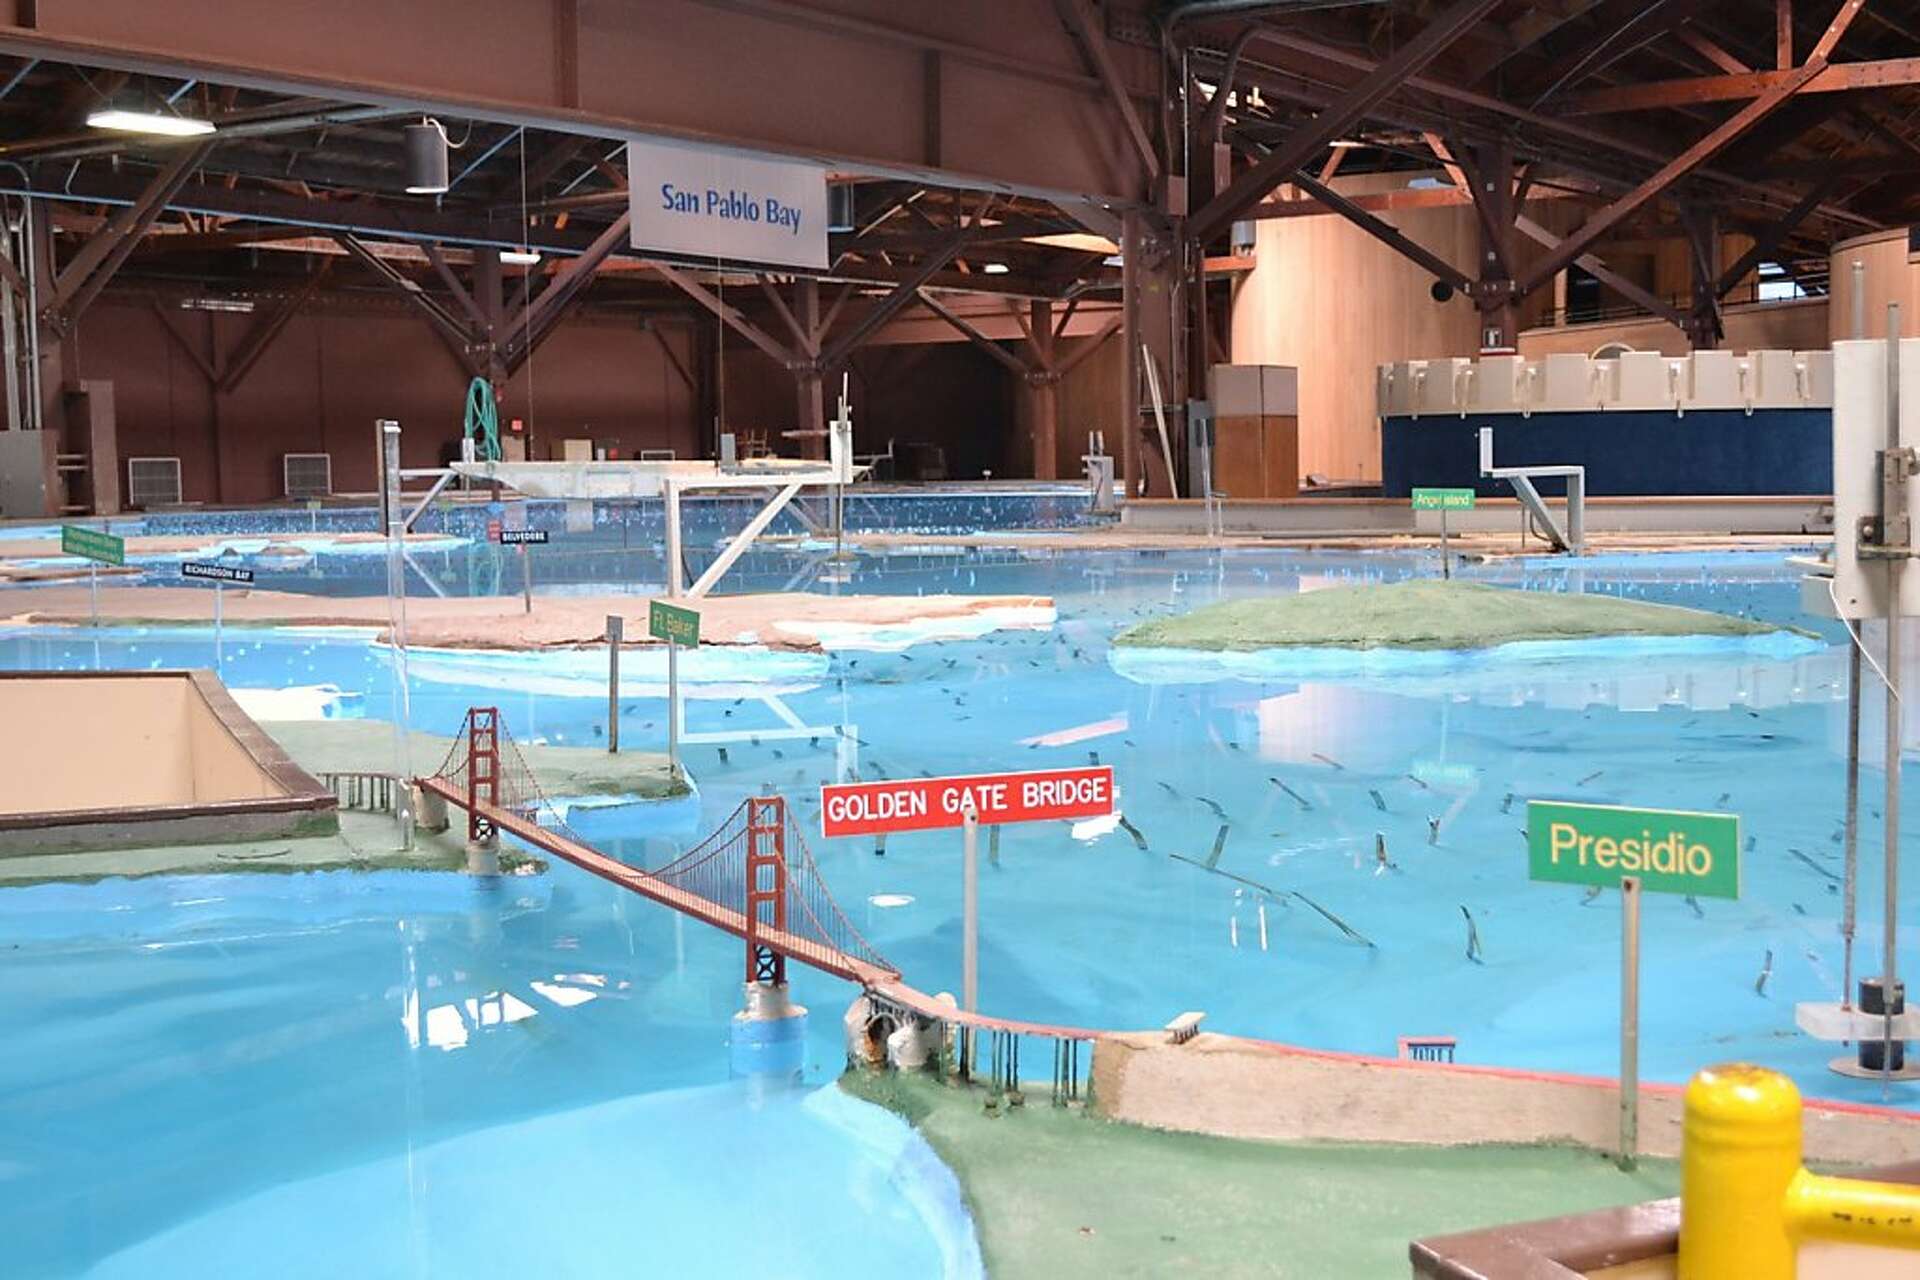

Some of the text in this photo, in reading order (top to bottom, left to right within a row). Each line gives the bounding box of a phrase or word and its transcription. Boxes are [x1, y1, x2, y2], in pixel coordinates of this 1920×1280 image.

[661, 184, 801, 235] San Pablo Bay
[828, 777, 1107, 822] GOLDEN GATE BRIDGE
[1550, 823, 1712, 876] Presidio
